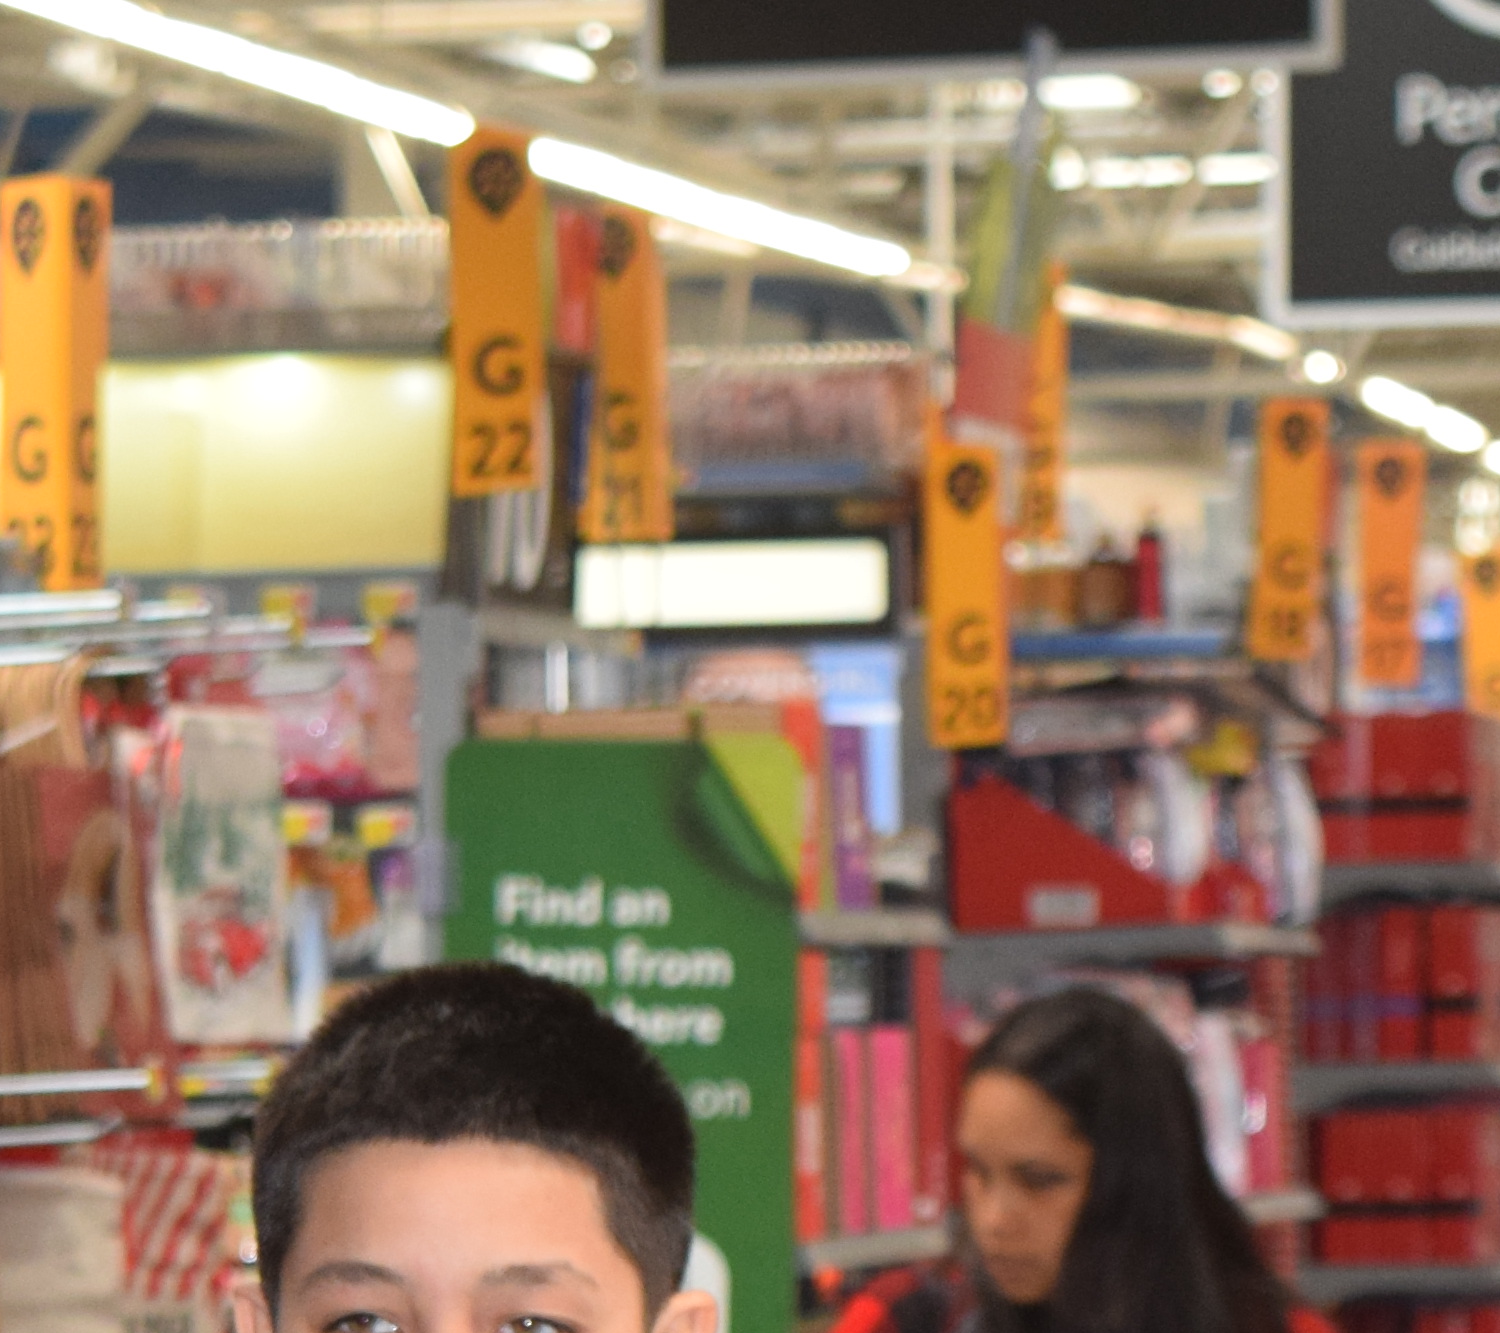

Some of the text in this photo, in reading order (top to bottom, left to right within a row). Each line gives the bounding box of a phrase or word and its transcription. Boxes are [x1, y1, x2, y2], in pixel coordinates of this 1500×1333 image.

[471, 335, 525, 398] G
[12, 414, 48, 483] G
[467, 419, 532, 480] 22
[948, 610, 992, 666] G
[495, 872, 672, 927] Find an
[614, 935, 734, 987] from
